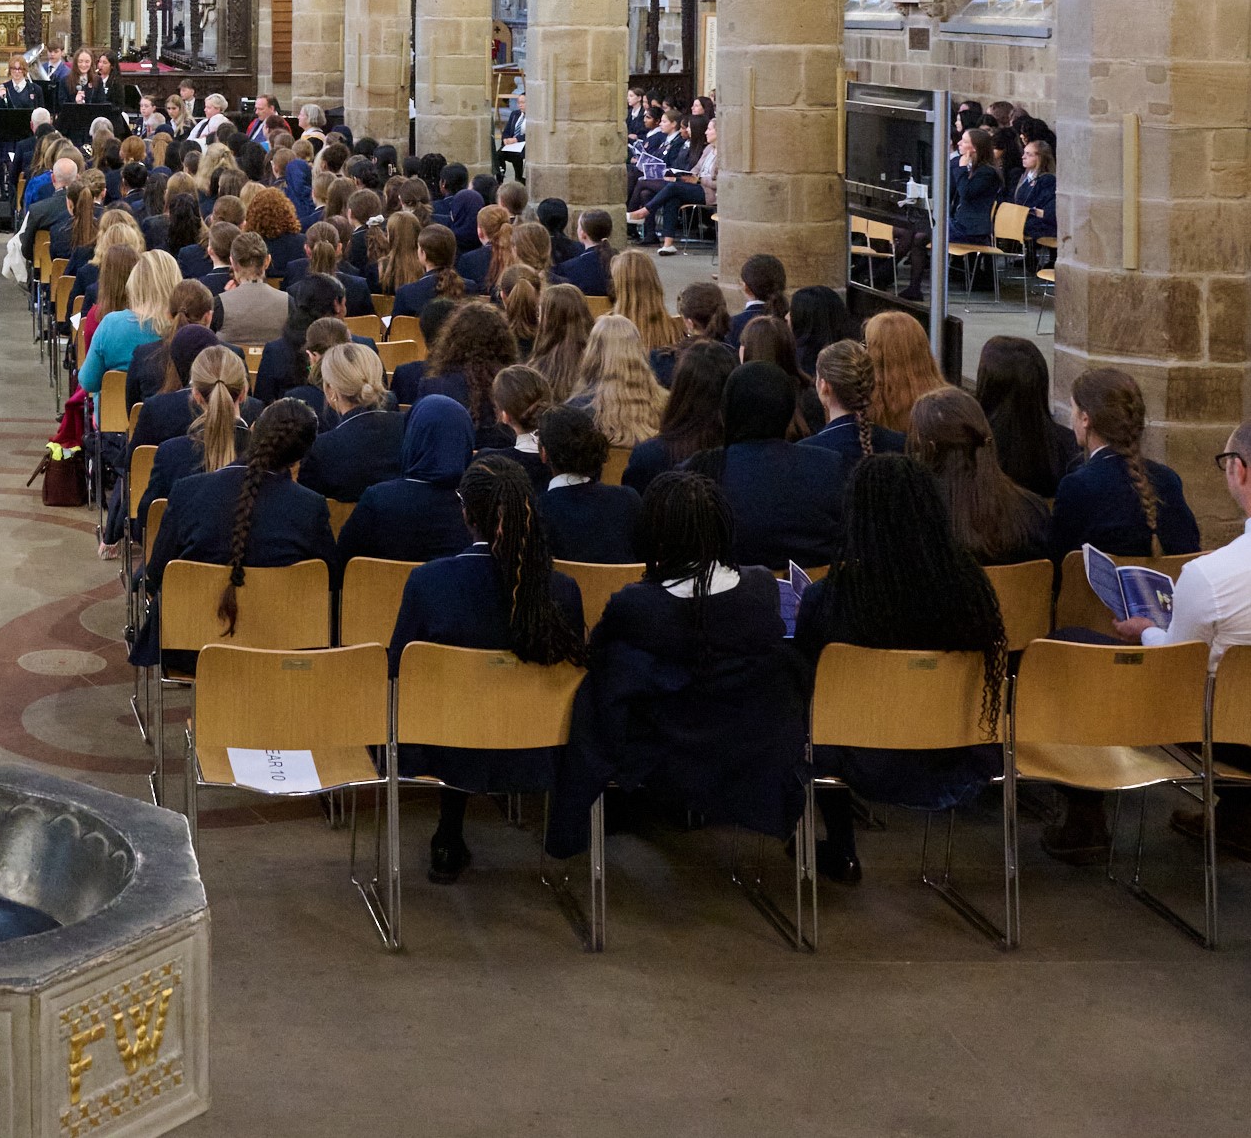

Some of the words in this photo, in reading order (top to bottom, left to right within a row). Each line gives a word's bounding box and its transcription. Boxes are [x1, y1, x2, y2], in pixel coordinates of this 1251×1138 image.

[265, 750, 283, 767] EAR
[270, 770, 286, 781] 10
[68, 988, 174, 1106] FW
